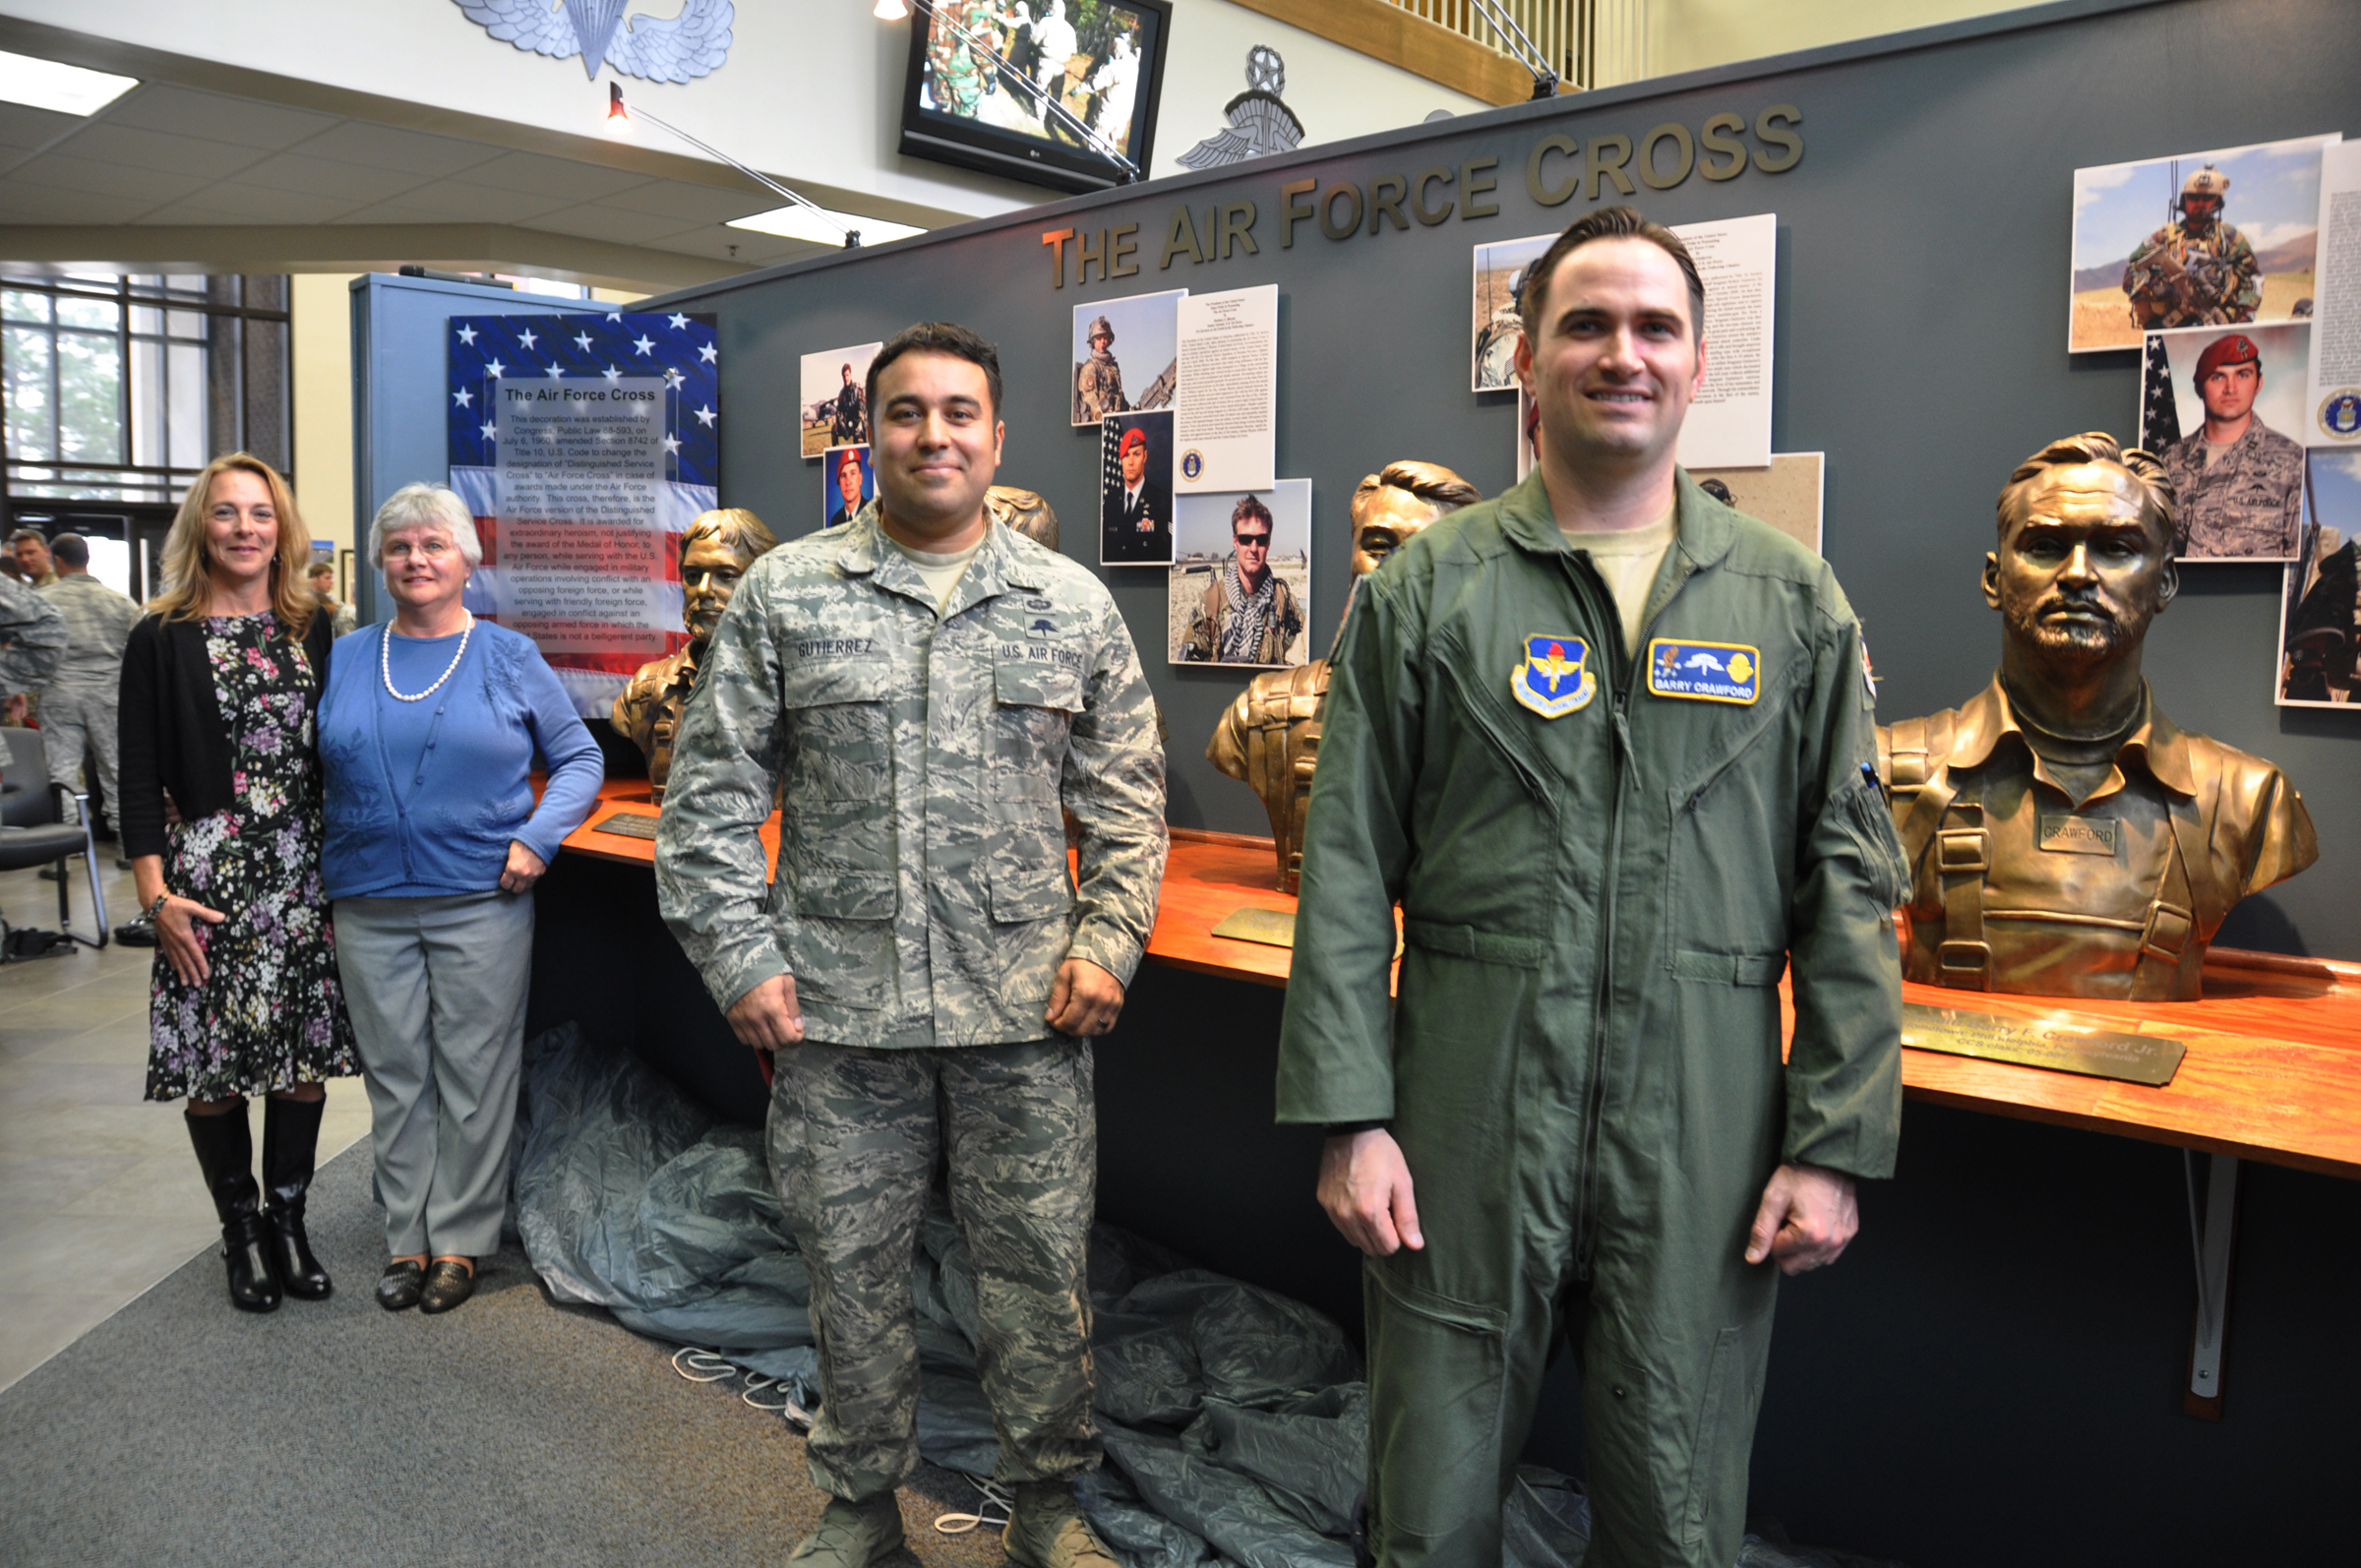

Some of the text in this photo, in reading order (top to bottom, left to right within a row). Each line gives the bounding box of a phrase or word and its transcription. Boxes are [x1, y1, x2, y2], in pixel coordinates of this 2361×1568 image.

[1043, 104, 1804, 288] THE AIR FORCE CROSS
[506, 389, 655, 401] The Air Force Cross
[507, 459, 552, 468] designation
[799, 638, 873, 657] GUTIERREZ
[1002, 645, 1082, 669] U.S. AIR FORCE
[1655, 679, 1753, 699] BARRY CRAWFORD
[2043, 825, 2112, 842] CRAWFORD
[2022, 1027, 2035, 1039] F.
[2043, 1030, 2131, 1053] Crawford
[2134, 1043, 2157, 1056] Jr.
